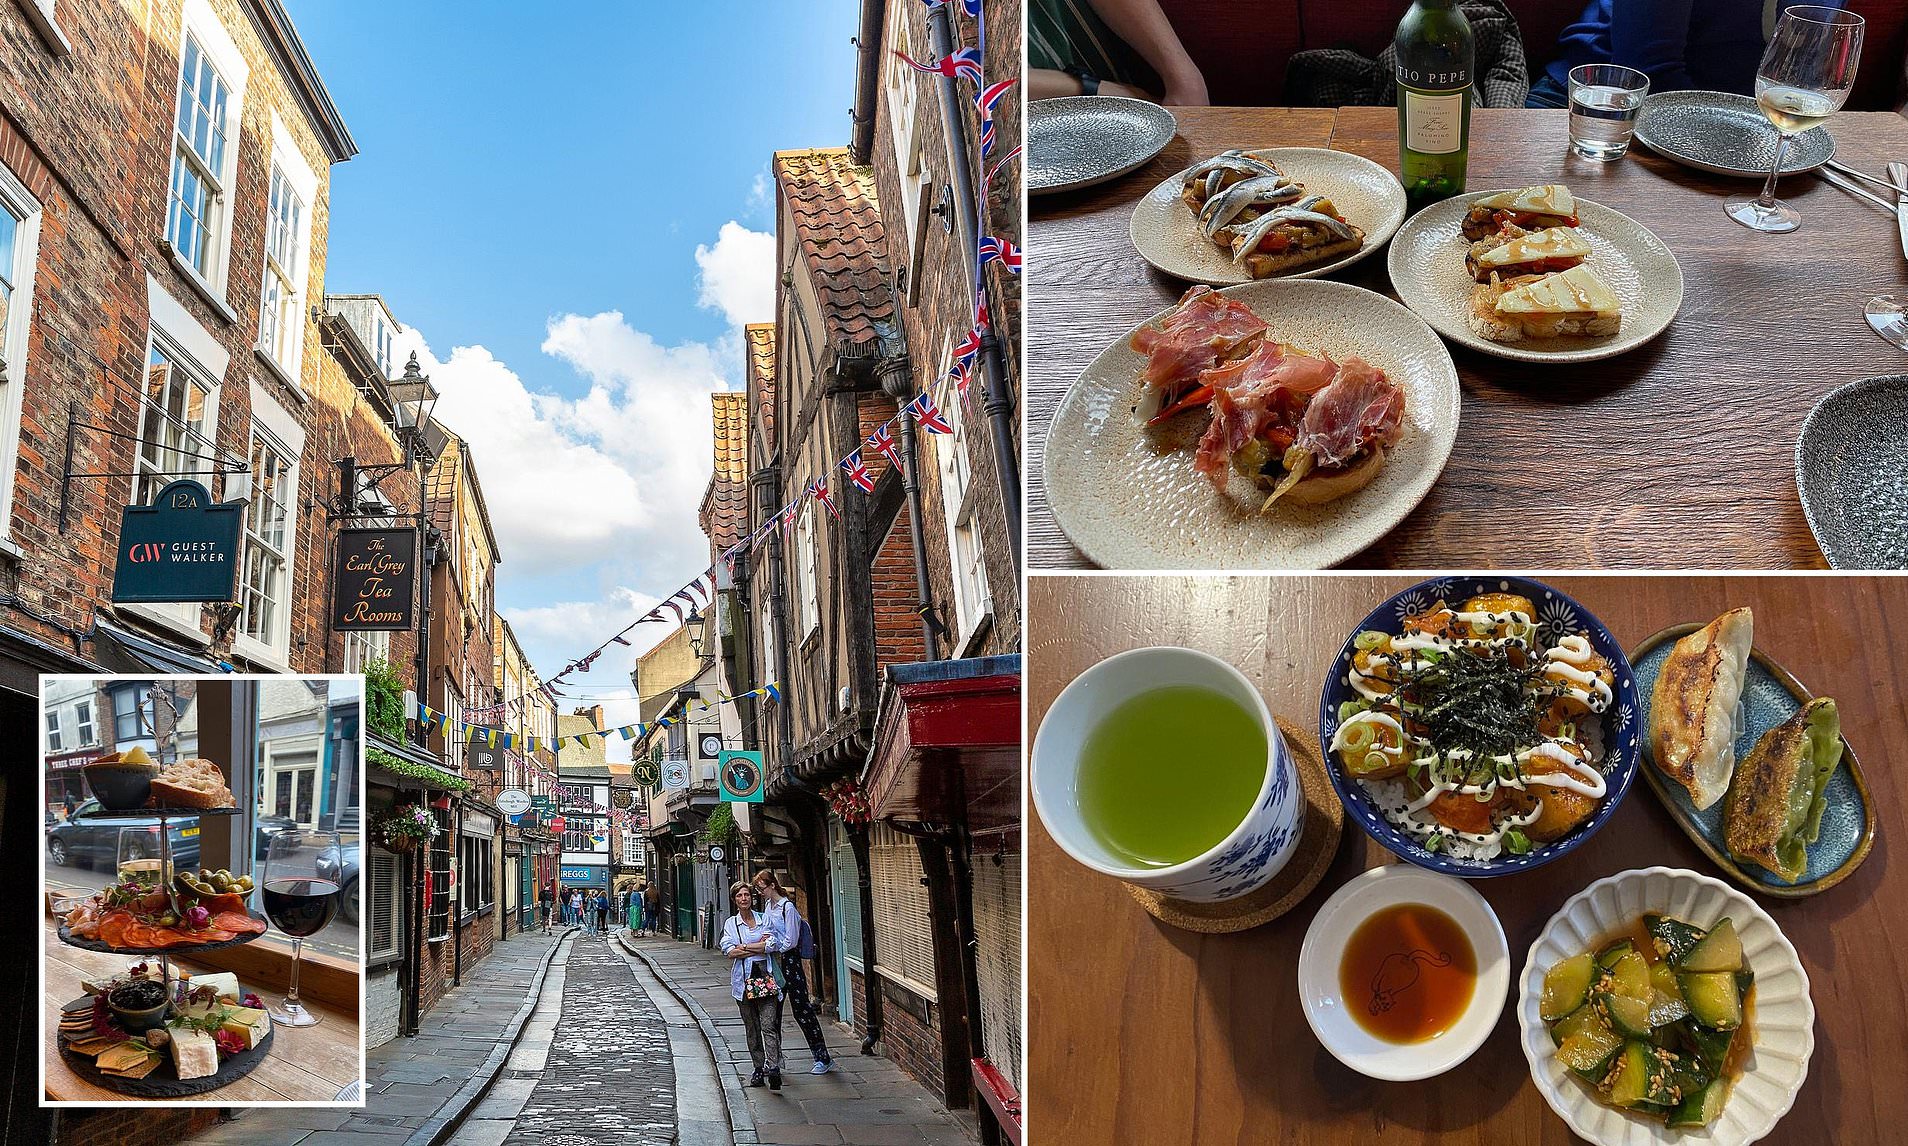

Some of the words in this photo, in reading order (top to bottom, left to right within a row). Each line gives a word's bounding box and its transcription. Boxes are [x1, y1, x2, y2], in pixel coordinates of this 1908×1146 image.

[1398, 65, 1419, 81] TIO
[1428, 70, 1465, 83] PEPE
[171, 542, 216, 551] GUEST
[367, 537, 385, 551] The
[171, 553, 224, 562] WALKER
[346, 553, 380, 571] Earl
[373, 554, 406, 576] Grey
[359, 577, 392, 599] Tea
[343, 601, 403, 623] Rooms
